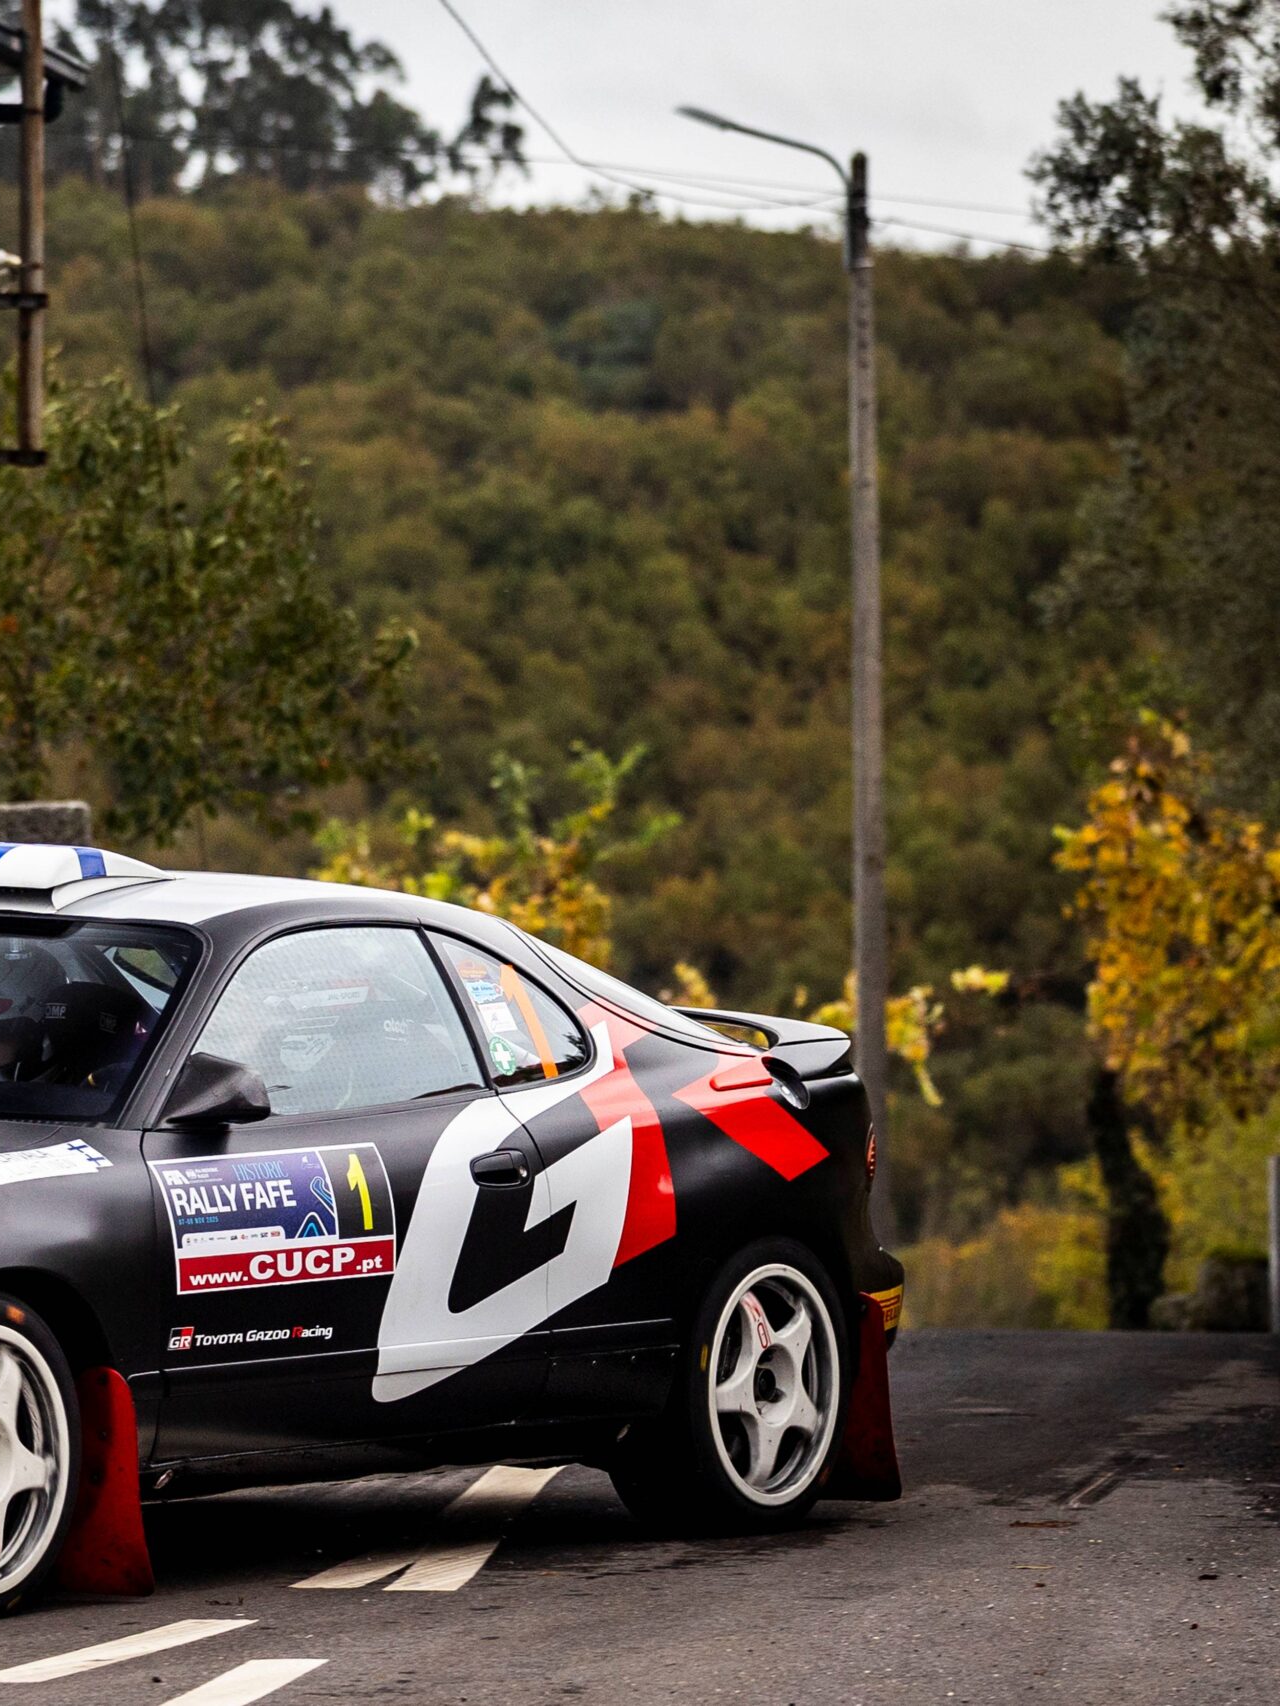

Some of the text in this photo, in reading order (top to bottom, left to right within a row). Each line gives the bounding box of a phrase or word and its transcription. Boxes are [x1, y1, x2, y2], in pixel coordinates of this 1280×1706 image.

[45, 1004, 67, 1017] OMP
[232, 1161, 289, 1181] HISTORIC
[170, 1179, 297, 1216] RALLY FAFE
[346, 1153, 374, 1230] 1
[189, 1246, 383, 1286] www.CUCP.pt
[169, 1325, 333, 1349] GR TOYOTA GAZOO Racing
